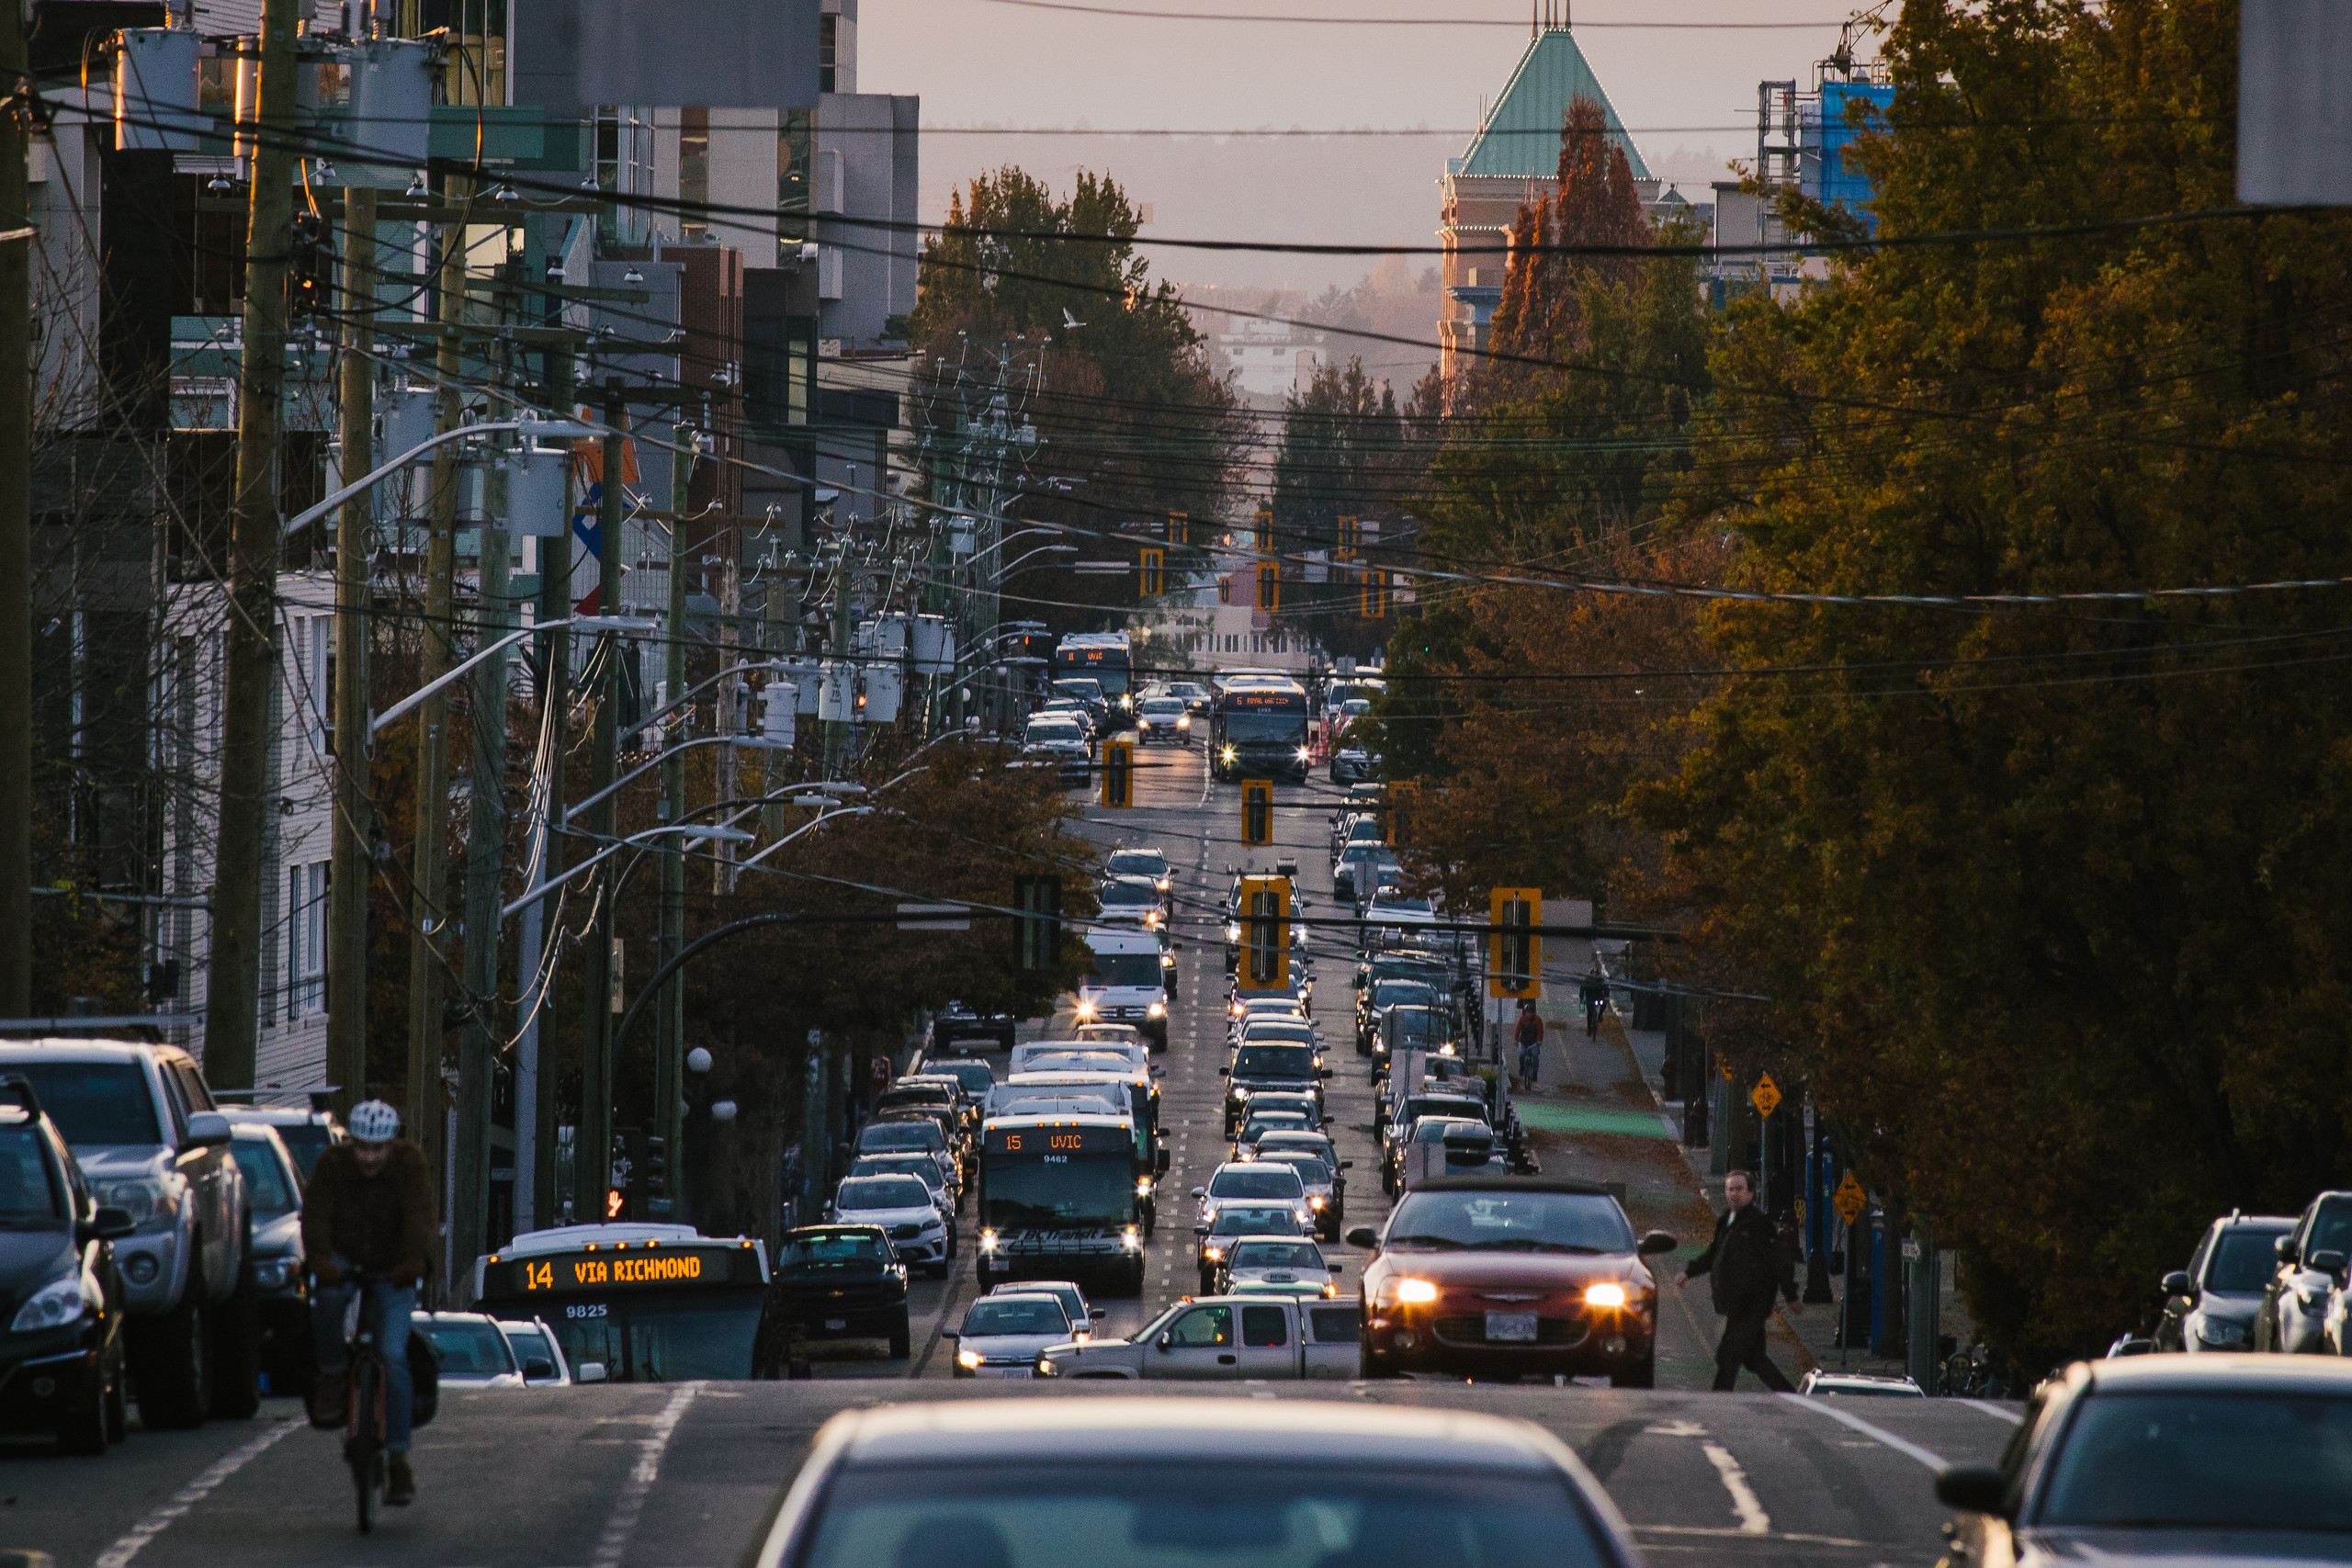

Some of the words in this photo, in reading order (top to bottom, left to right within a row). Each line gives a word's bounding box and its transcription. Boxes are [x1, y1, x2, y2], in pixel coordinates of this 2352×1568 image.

[1237, 696, 1242, 705] 6
[1006, 1134, 1022, 1150] 15
[1050, 1134, 1081, 1149] UVIC
[1044, 1155, 1068, 1163] 9462
[526, 1261, 554, 1291] 14
[574, 1260, 607, 1284] VIA
[614, 1256, 701, 1282] RICHMOND
[566, 1303, 608, 1319] 9825
